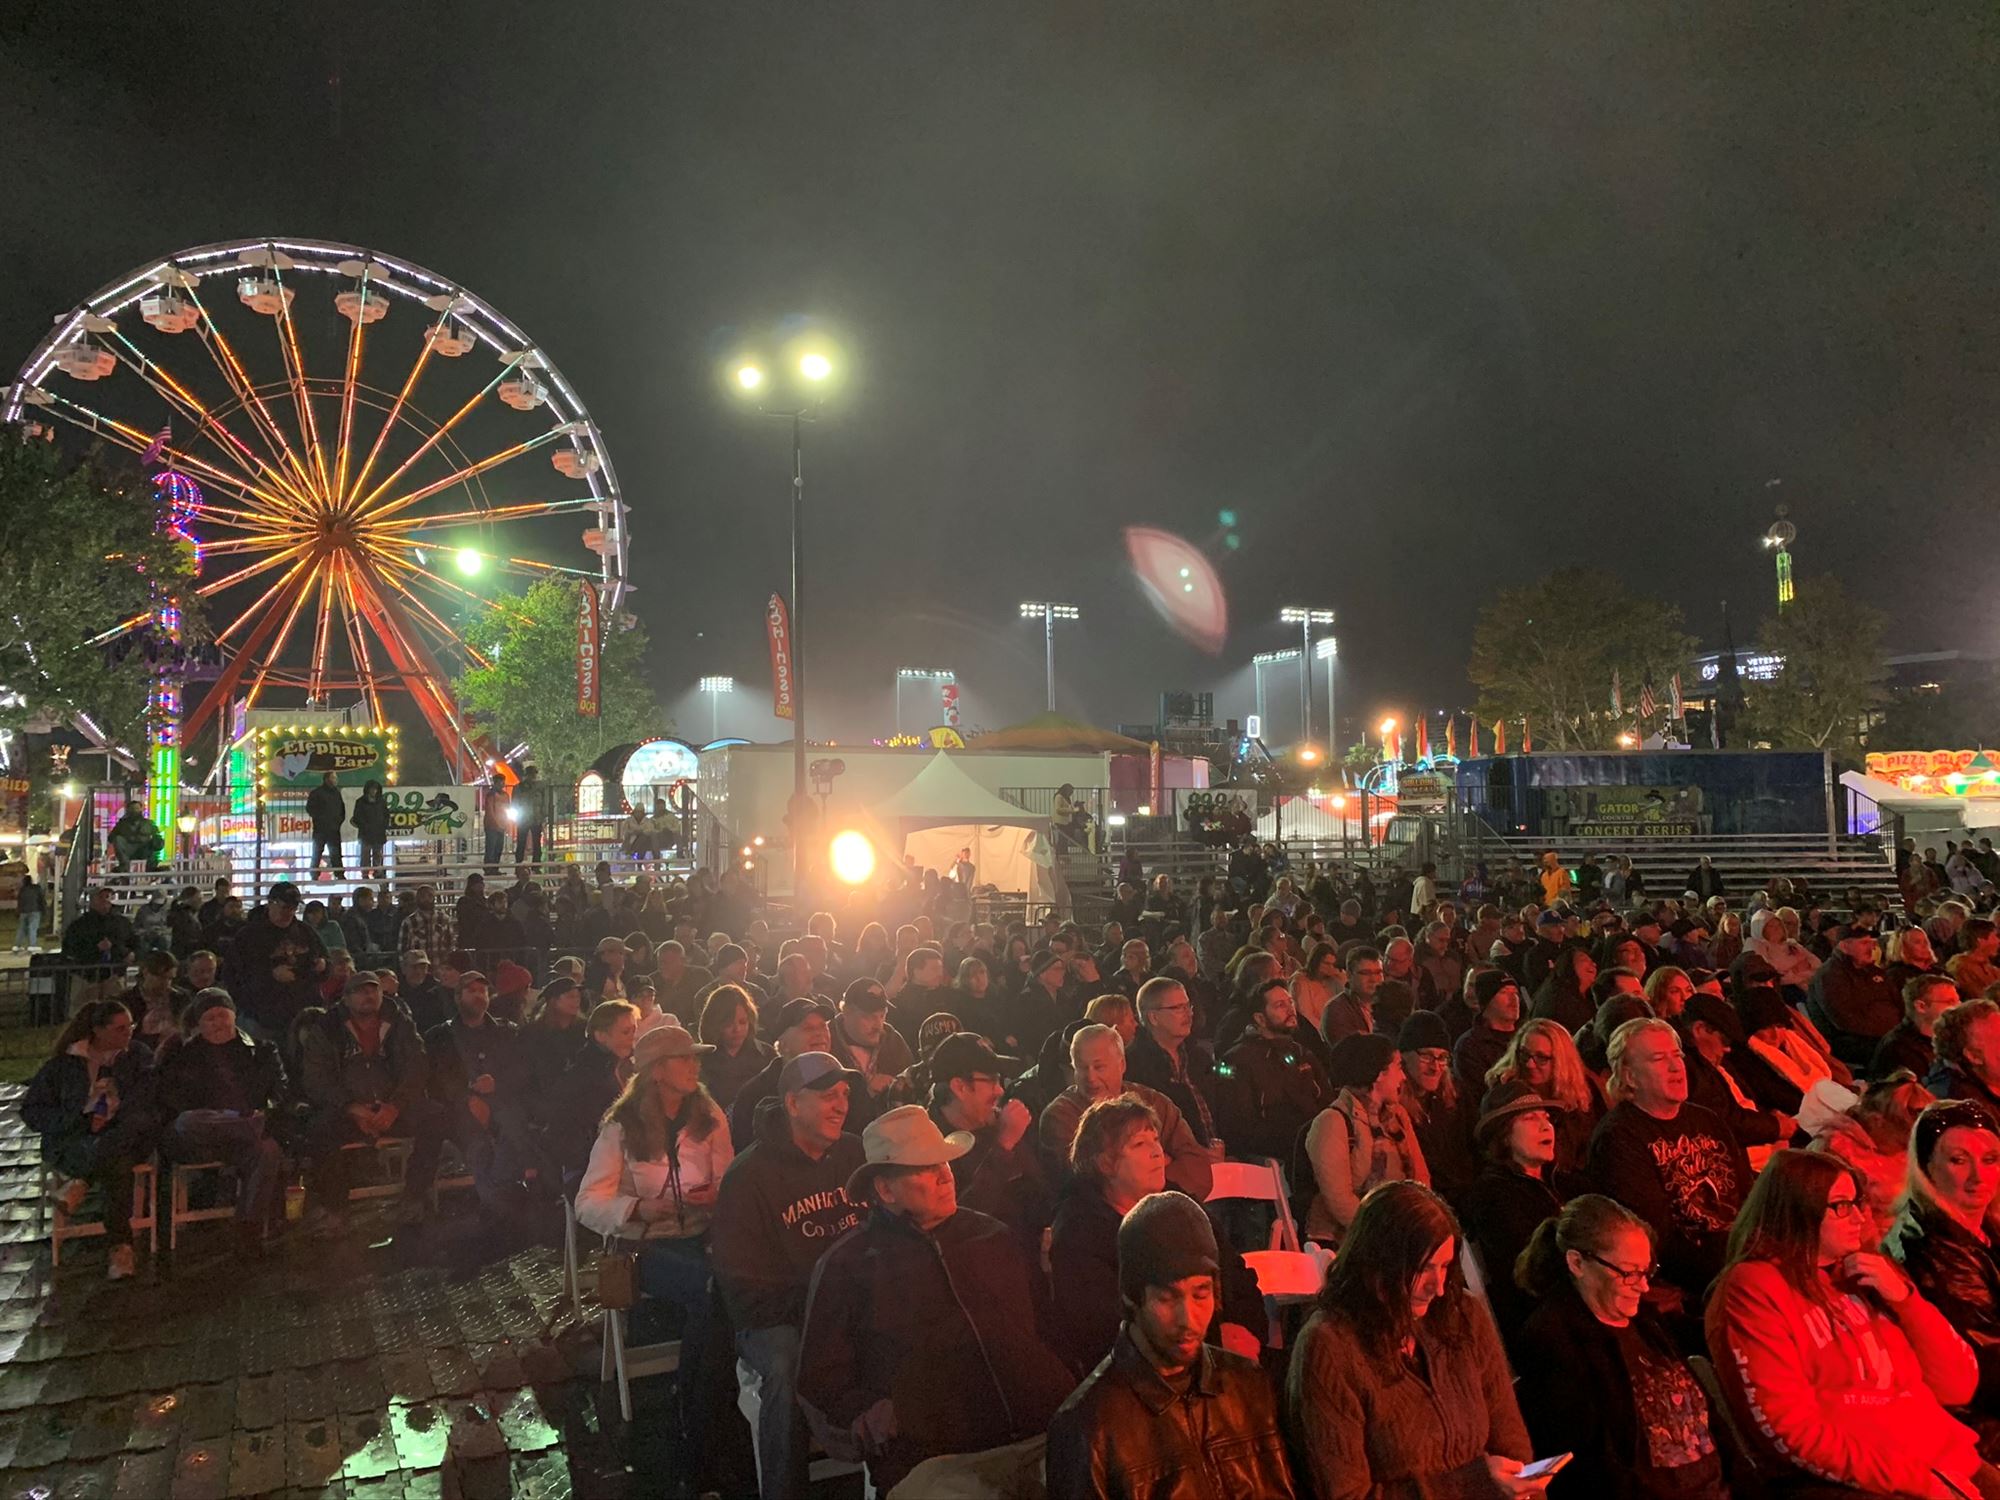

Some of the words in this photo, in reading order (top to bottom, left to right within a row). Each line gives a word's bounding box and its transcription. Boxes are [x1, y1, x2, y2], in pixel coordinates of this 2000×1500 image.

[282, 740, 376, 756] Elephant
[334, 756, 374, 768] Ears
[1887, 754, 1928, 768] PIZZA
[1600, 803, 1640, 814] GATOR
[1576, 825, 1639, 836] CONCERT
[1644, 824, 1692, 835] SERIES
